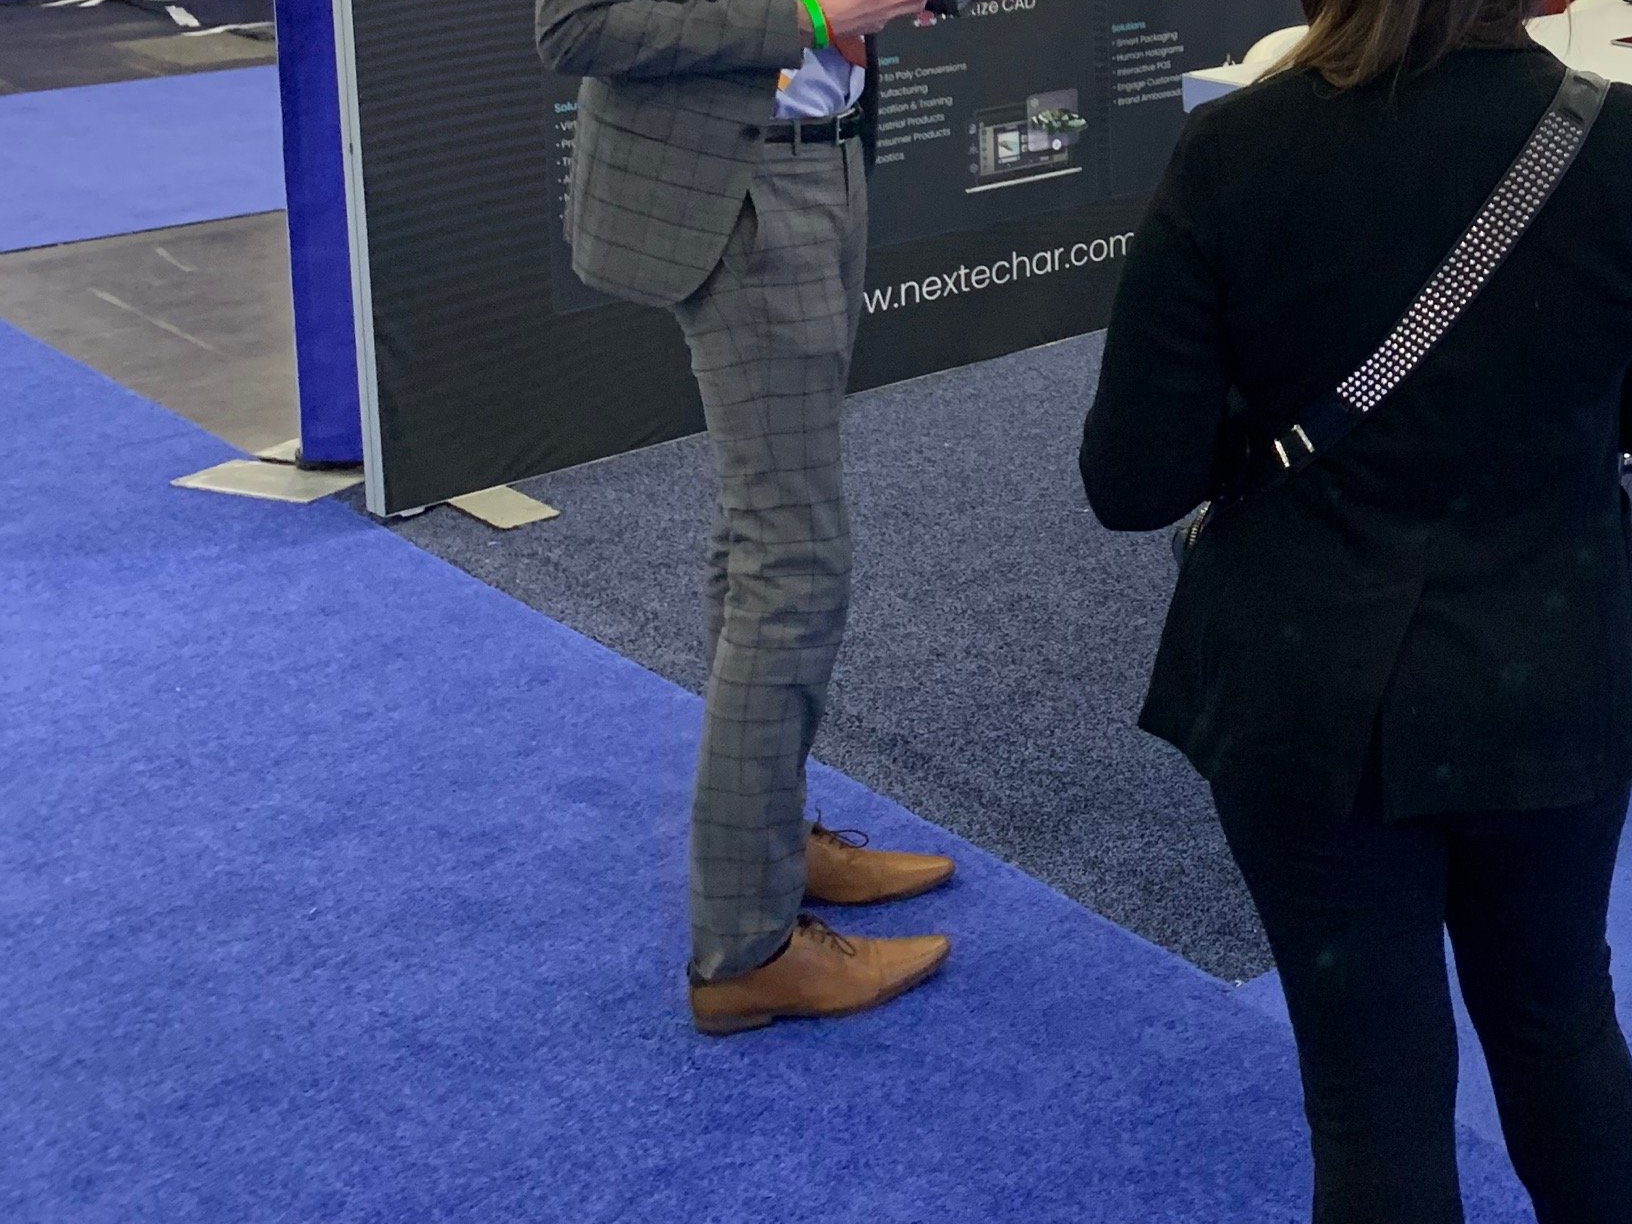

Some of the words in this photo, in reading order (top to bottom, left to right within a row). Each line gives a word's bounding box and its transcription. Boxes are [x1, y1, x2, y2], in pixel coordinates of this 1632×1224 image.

[1140, 31, 1179, 45] Packaging
[895, 69, 914, 80] Poly
[914, 63, 968, 77] Conversions
[919, 96, 954, 108] Training
[906, 114, 946, 126] Products
[912, 128, 951, 141] Products
